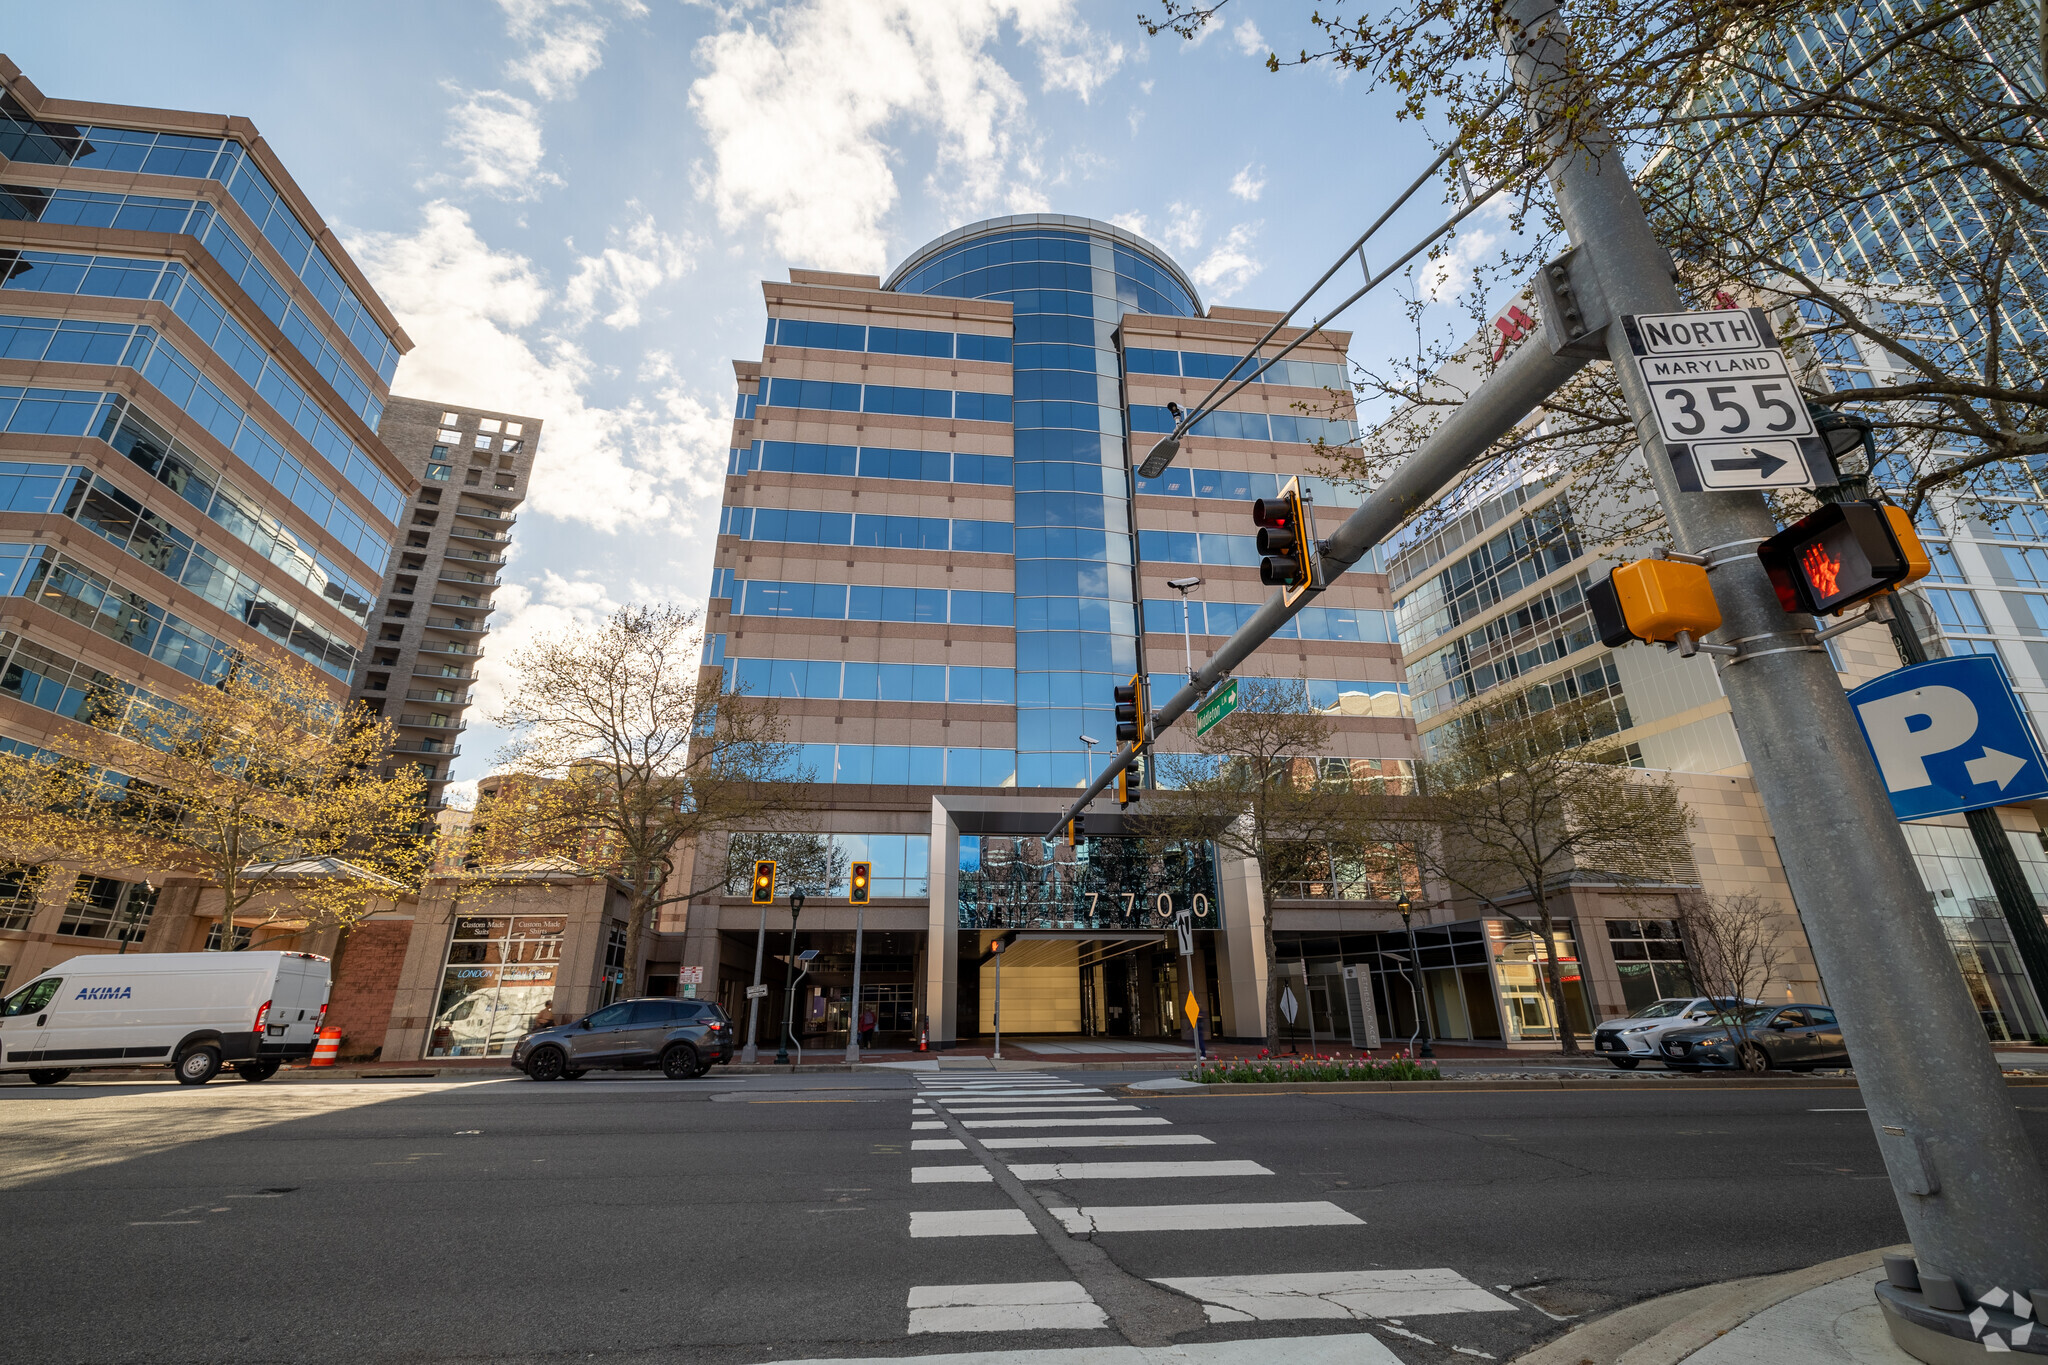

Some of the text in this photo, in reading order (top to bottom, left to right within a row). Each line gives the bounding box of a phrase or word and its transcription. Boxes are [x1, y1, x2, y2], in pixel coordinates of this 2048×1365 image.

[1646, 319, 1752, 346] NORTH
[1654, 357, 1770, 375] MARYLAND
[1665, 383, 1797, 435] 355
[1198, 705, 1220, 731] Middleton
[1857, 684, 1979, 793] P
[1084, 892, 1208, 917] 7700
[457, 969, 494, 978] LONDON
[74, 986, 132, 1001] AKIMA
[1360, 971, 1377, 1041] BETHESDA PLACE
